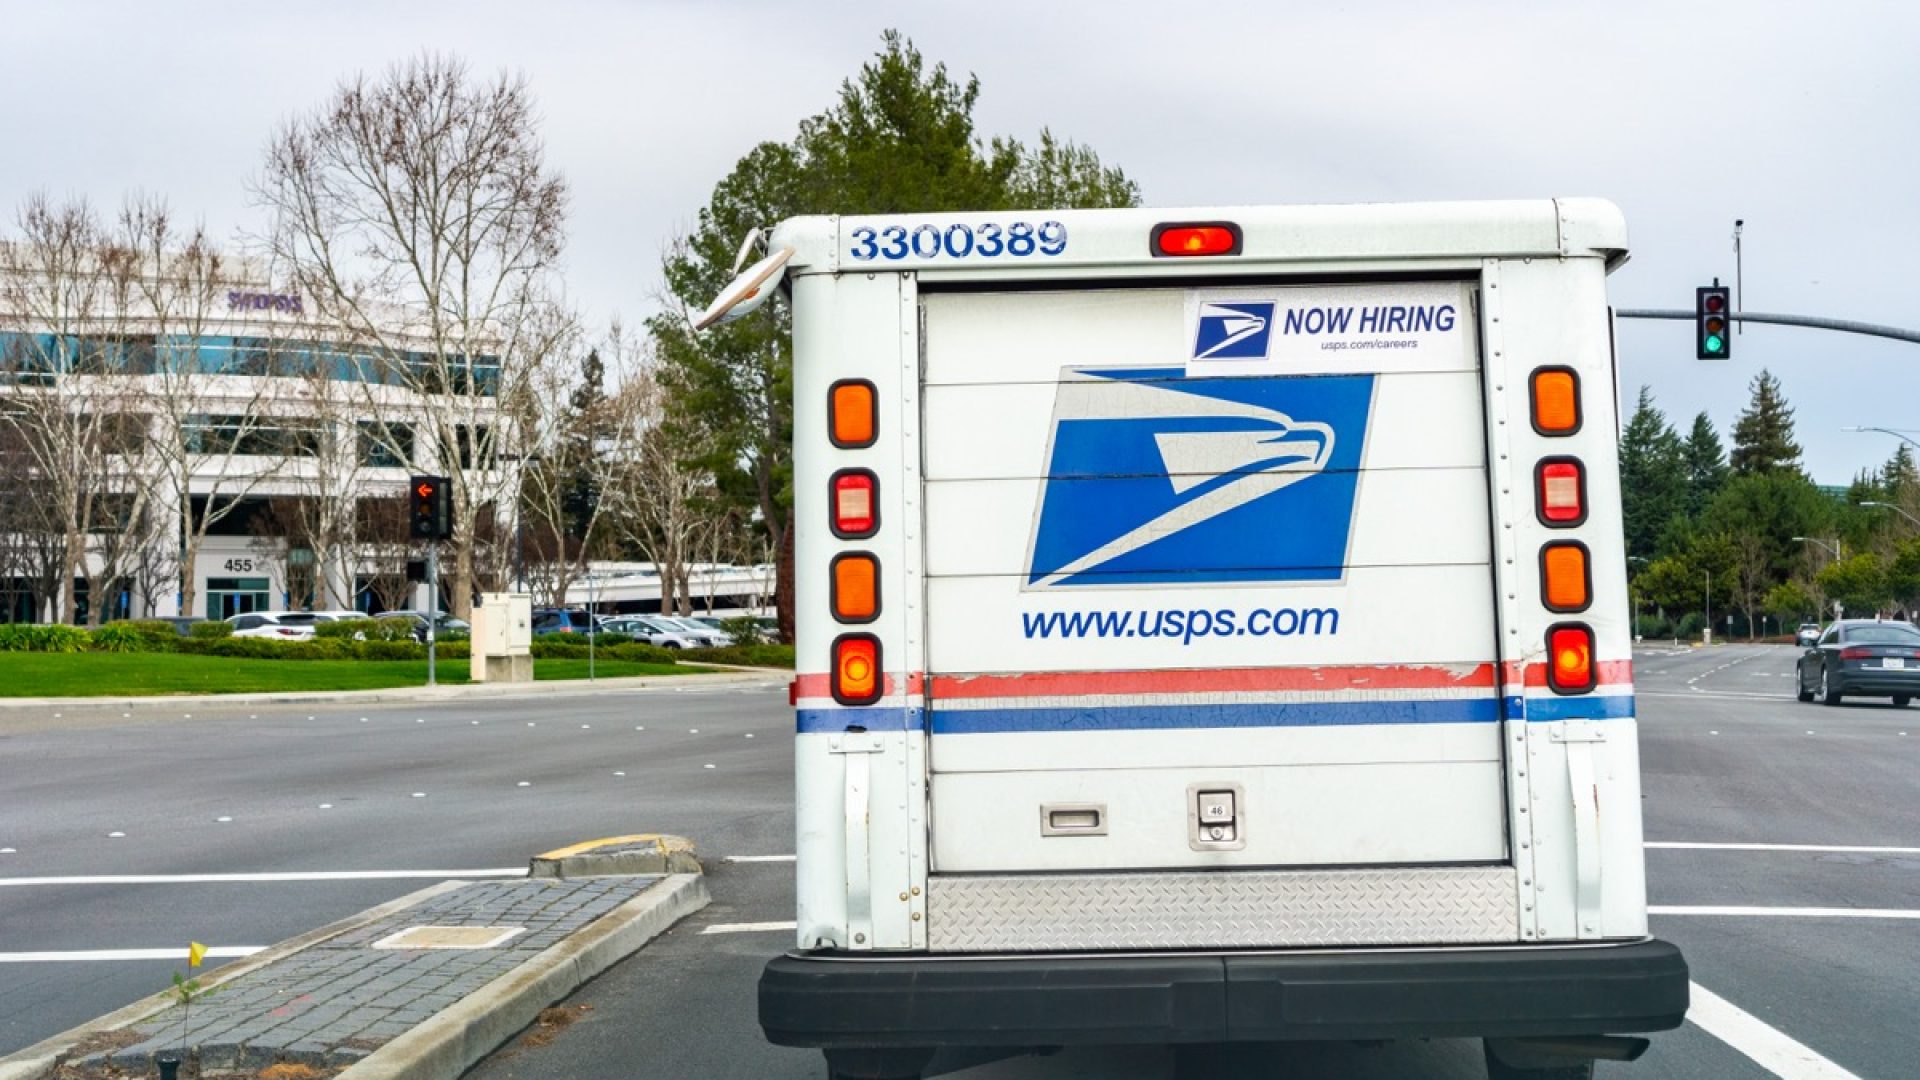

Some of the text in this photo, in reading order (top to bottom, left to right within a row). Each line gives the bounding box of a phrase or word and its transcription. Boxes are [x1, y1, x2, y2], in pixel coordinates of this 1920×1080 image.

[850, 220, 1068, 261] 3300389
[1284, 304, 1456, 335] NOW HIRING
[1321, 339, 1418, 351] usps.com/careers
[224, 559, 252, 572] 455
[1022, 607, 1340, 646] www.usps.com
